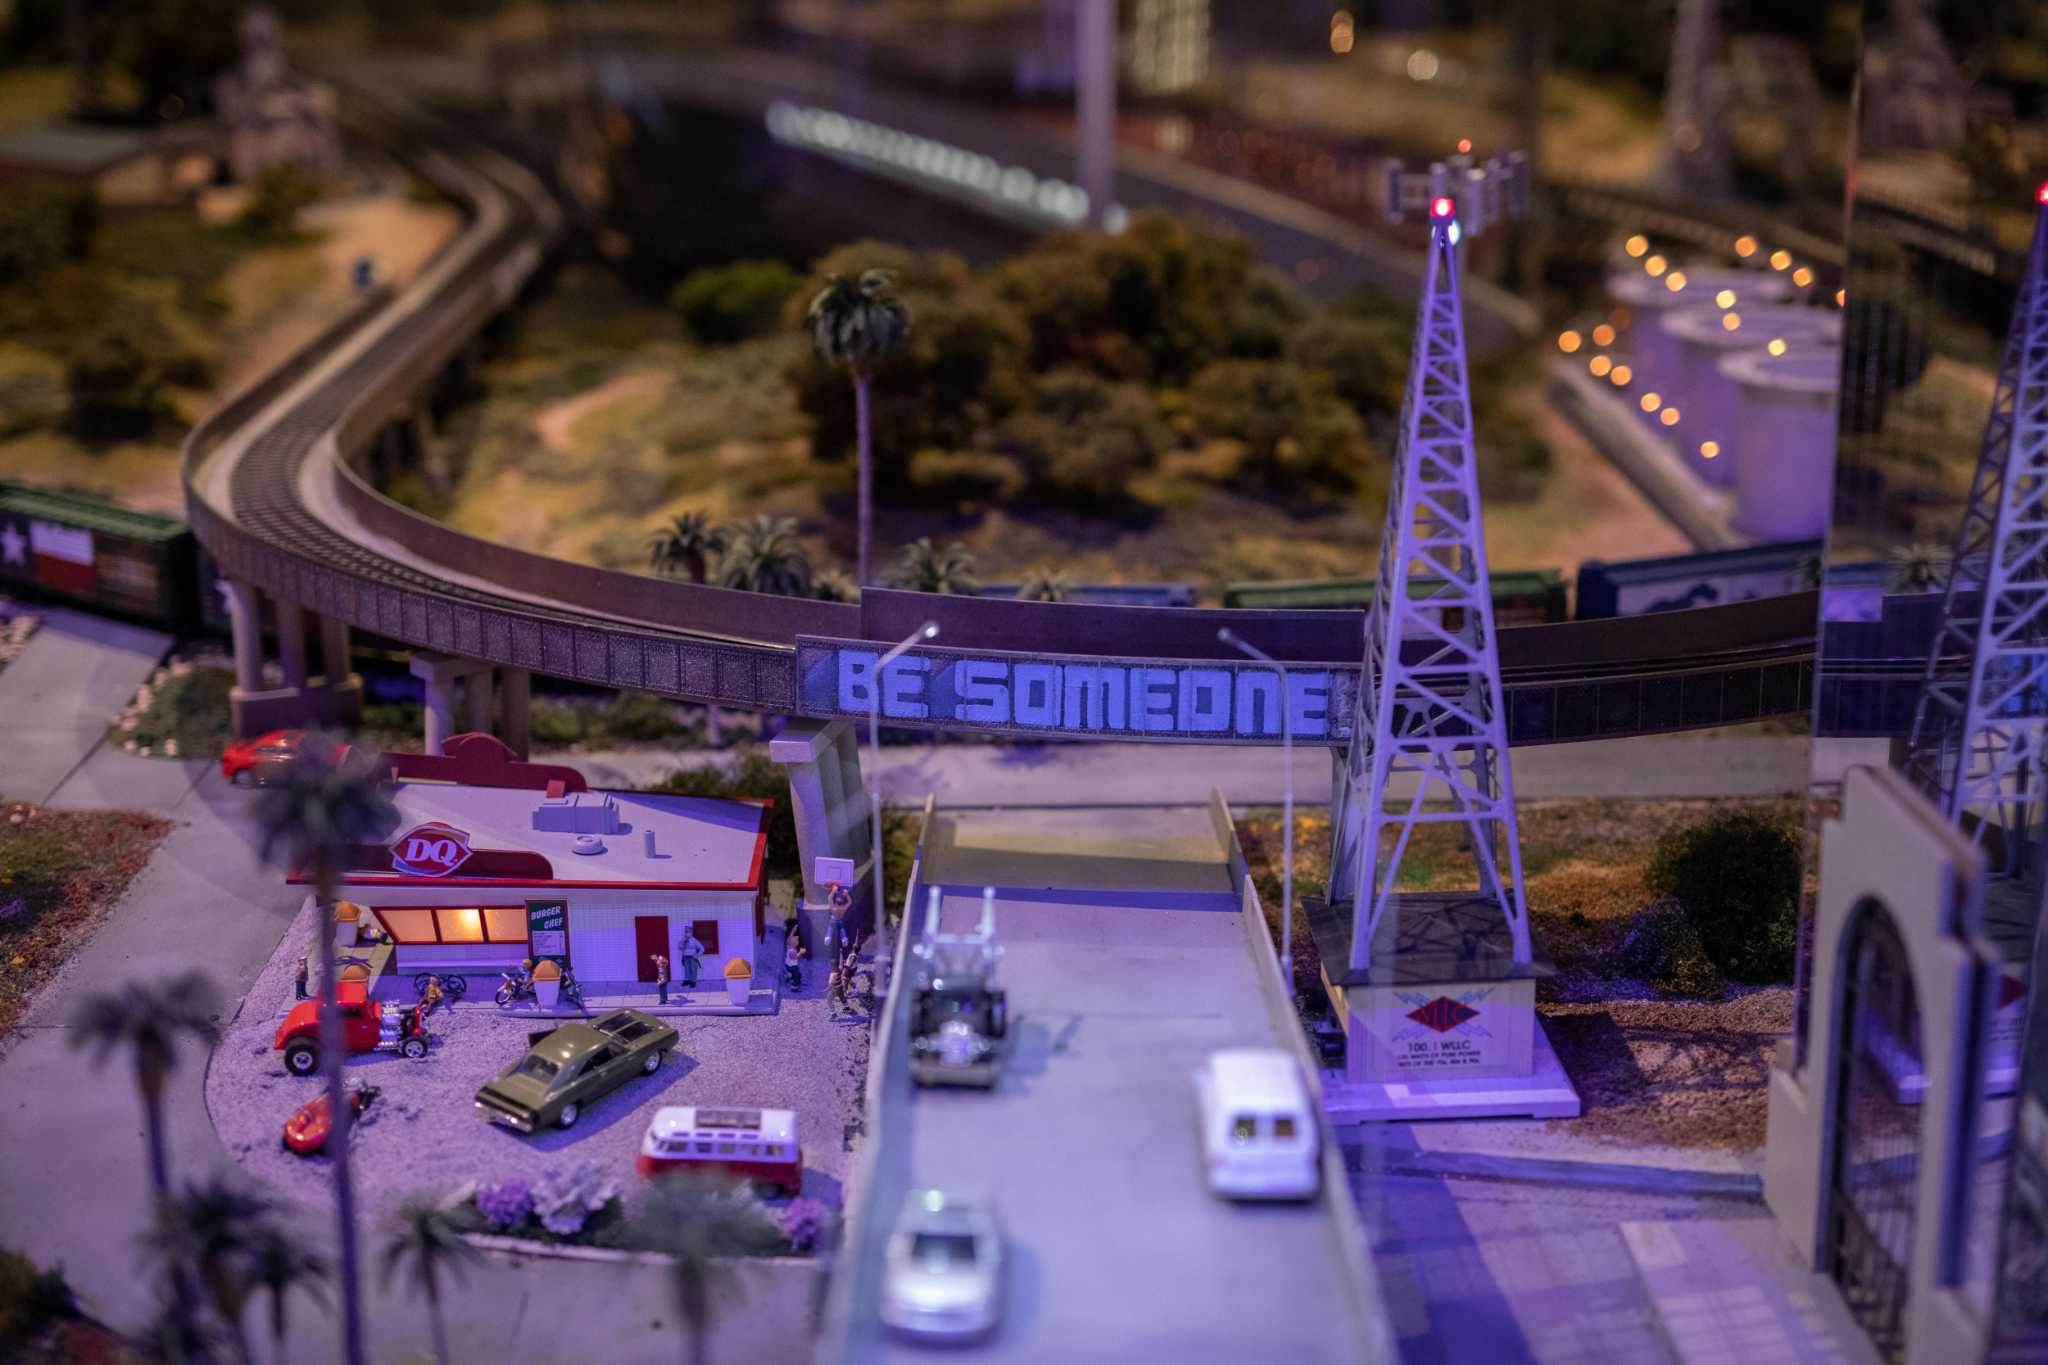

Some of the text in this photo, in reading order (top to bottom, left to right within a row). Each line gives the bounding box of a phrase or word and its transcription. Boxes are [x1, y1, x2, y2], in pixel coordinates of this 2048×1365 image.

[839, 649, 927, 718] BE
[954, 659, 1329, 735] SOMEONE
[405, 838, 456, 866] DQ
[530, 905, 561, 921] BURGER
[544, 917, 563, 929] CHEF
